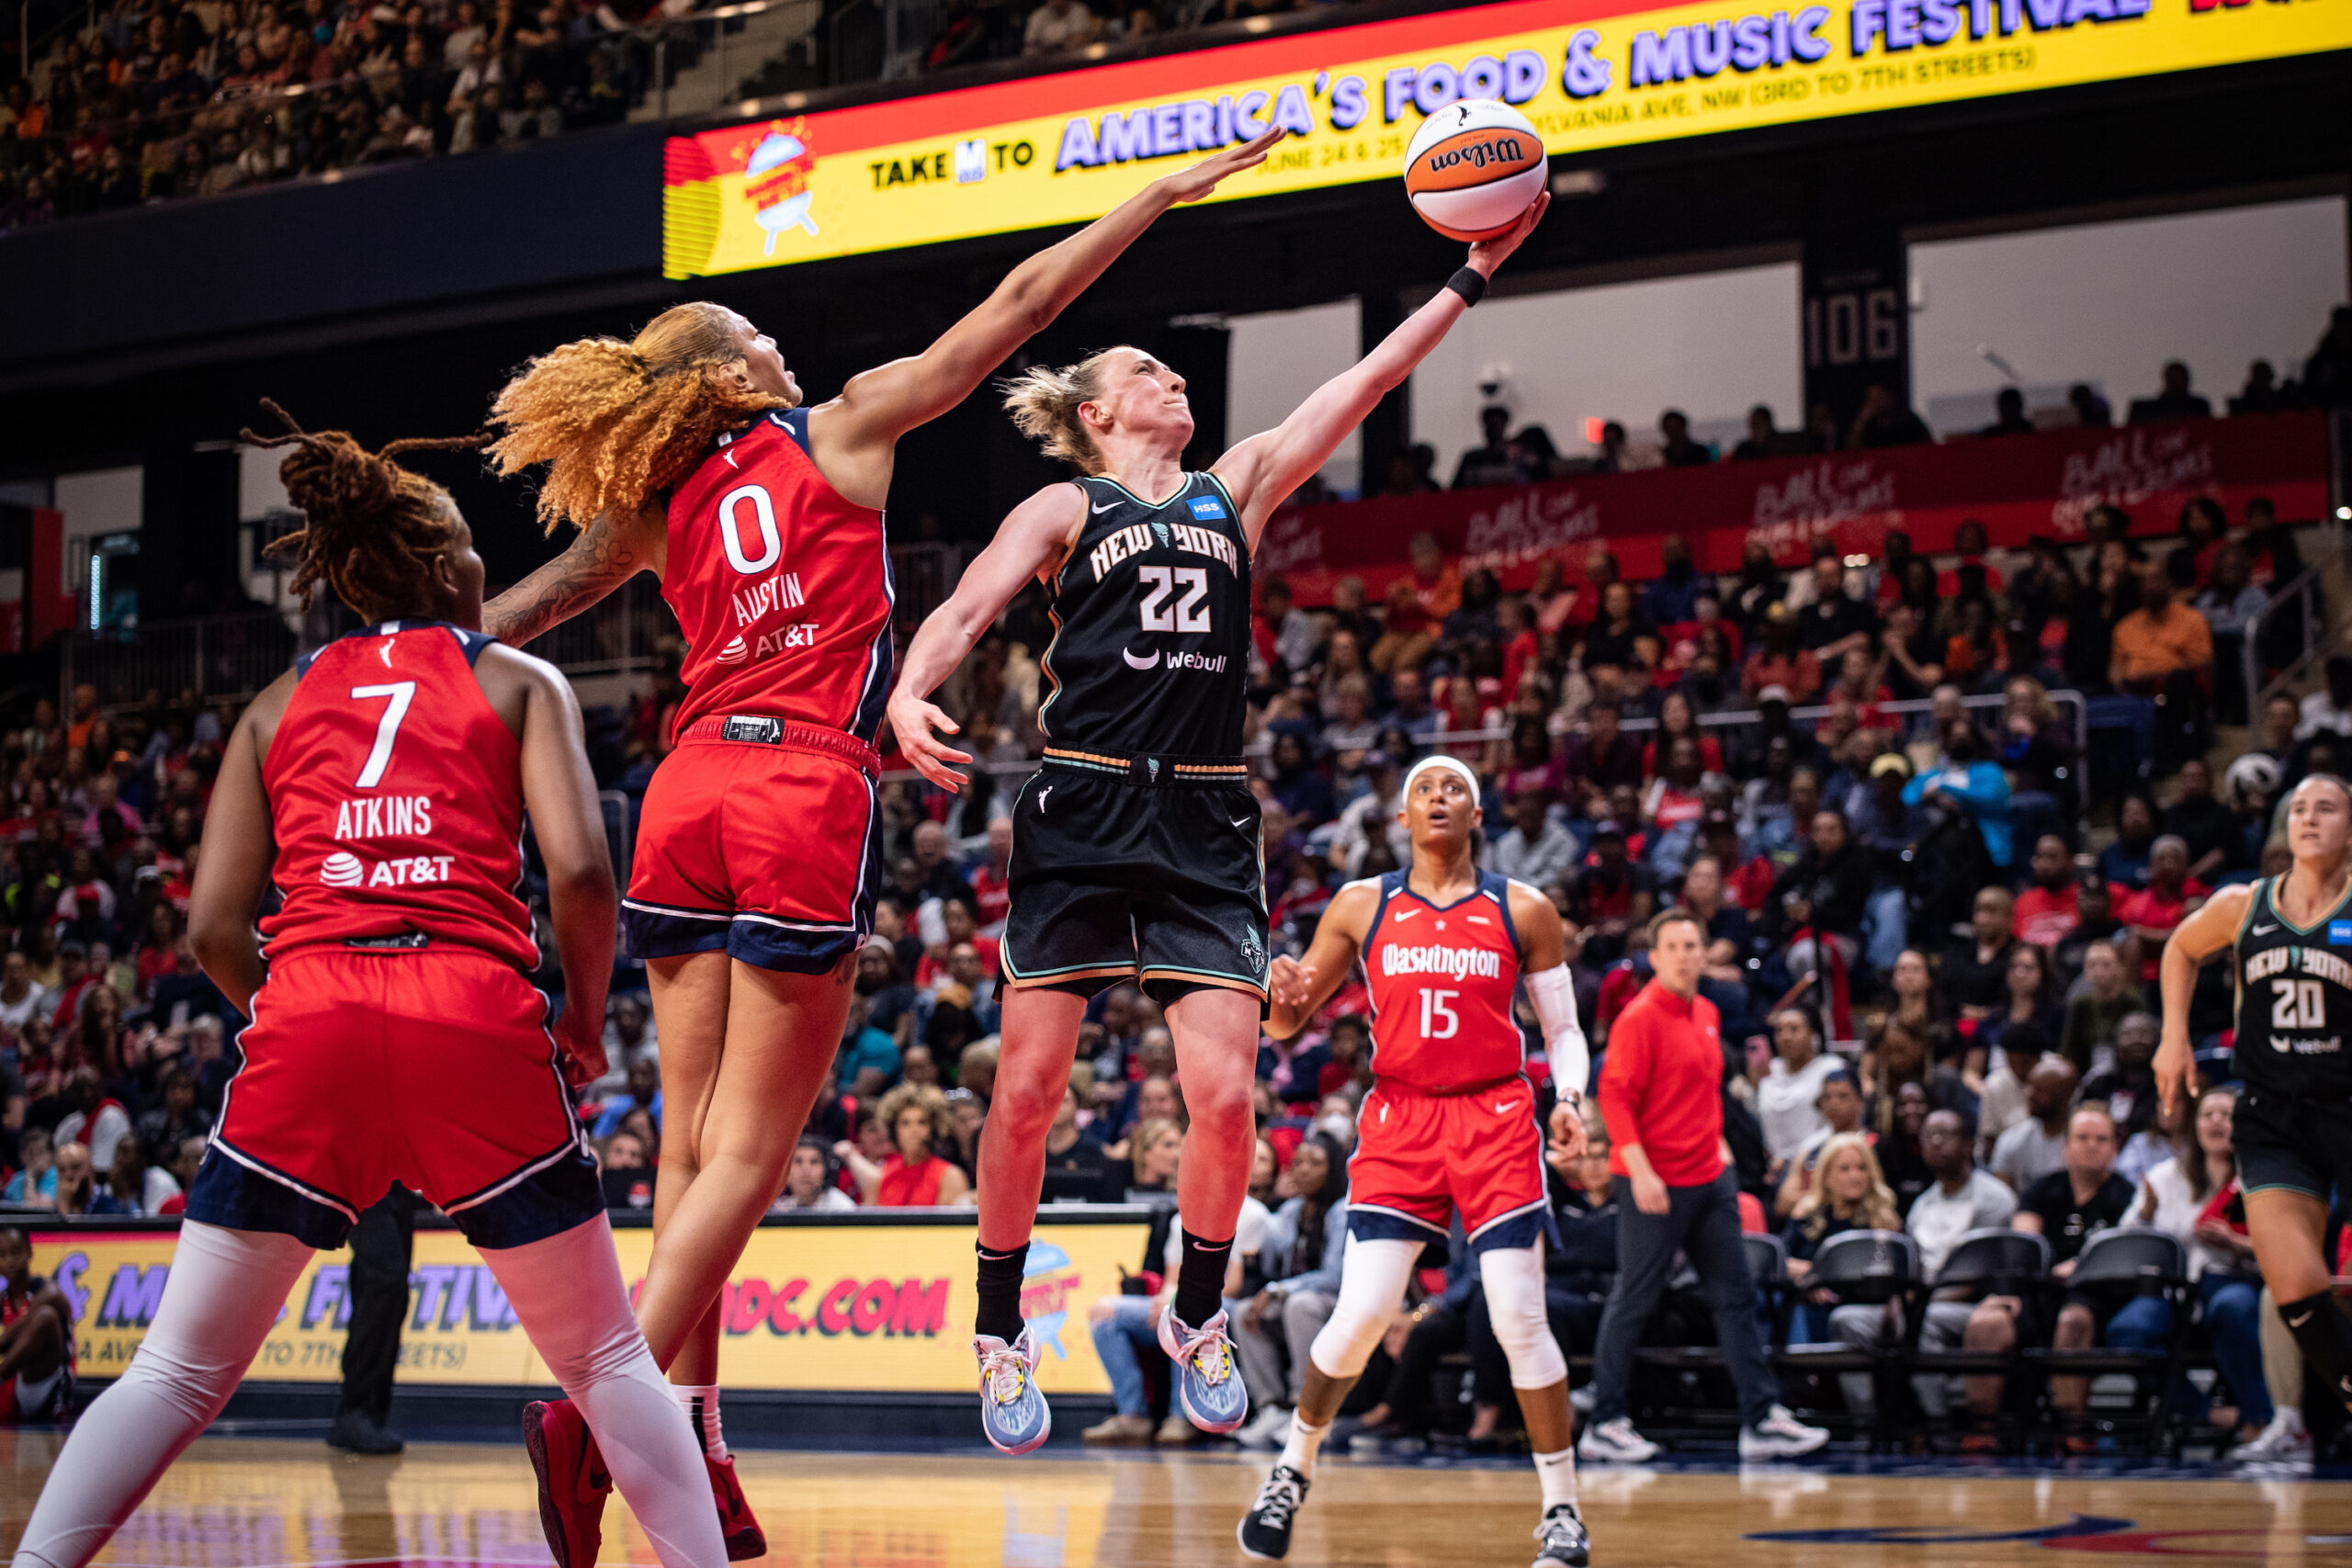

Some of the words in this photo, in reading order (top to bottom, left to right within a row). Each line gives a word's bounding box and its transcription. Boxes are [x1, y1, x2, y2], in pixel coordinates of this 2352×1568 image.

[870, 152, 947, 188] TAKE
[993, 141, 1034, 171] TO
[1055, 70, 1370, 174] AMERICA'S
[1384, 49, 1547, 124] FOOD
[1563, 28, 1612, 98] &
[1629, 6, 1831, 88] MUSIC
[1849, 0, 2152, 57] FESTIV
[1815, 71, 1851, 95] TO
[1860, 64, 1906, 89] 7TH
[1430, 138, 1523, 173] Wilson
[1807, 289, 1897, 367] 106
[718, 483, 781, 575] 0
[1193, 502, 1220, 513] HSS
[1090, 523, 1153, 583] NEW
[731, 572, 805, 627] AUSTIN
[1138, 565, 1212, 633] 22
[754, 624, 819, 659] AT&T
[1166, 650, 1227, 673] Webull
[350, 681, 416, 788] 7
[334, 796, 432, 840] ATKINS
[368, 856, 455, 887] AT&T
[1382, 942, 1500, 982] Washington
[2245, 946, 2289, 985] NEW
[1419, 987, 1460, 1040] 15
[2271, 978, 2326, 1029] 20
[263, 1340, 295, 1366] TO
